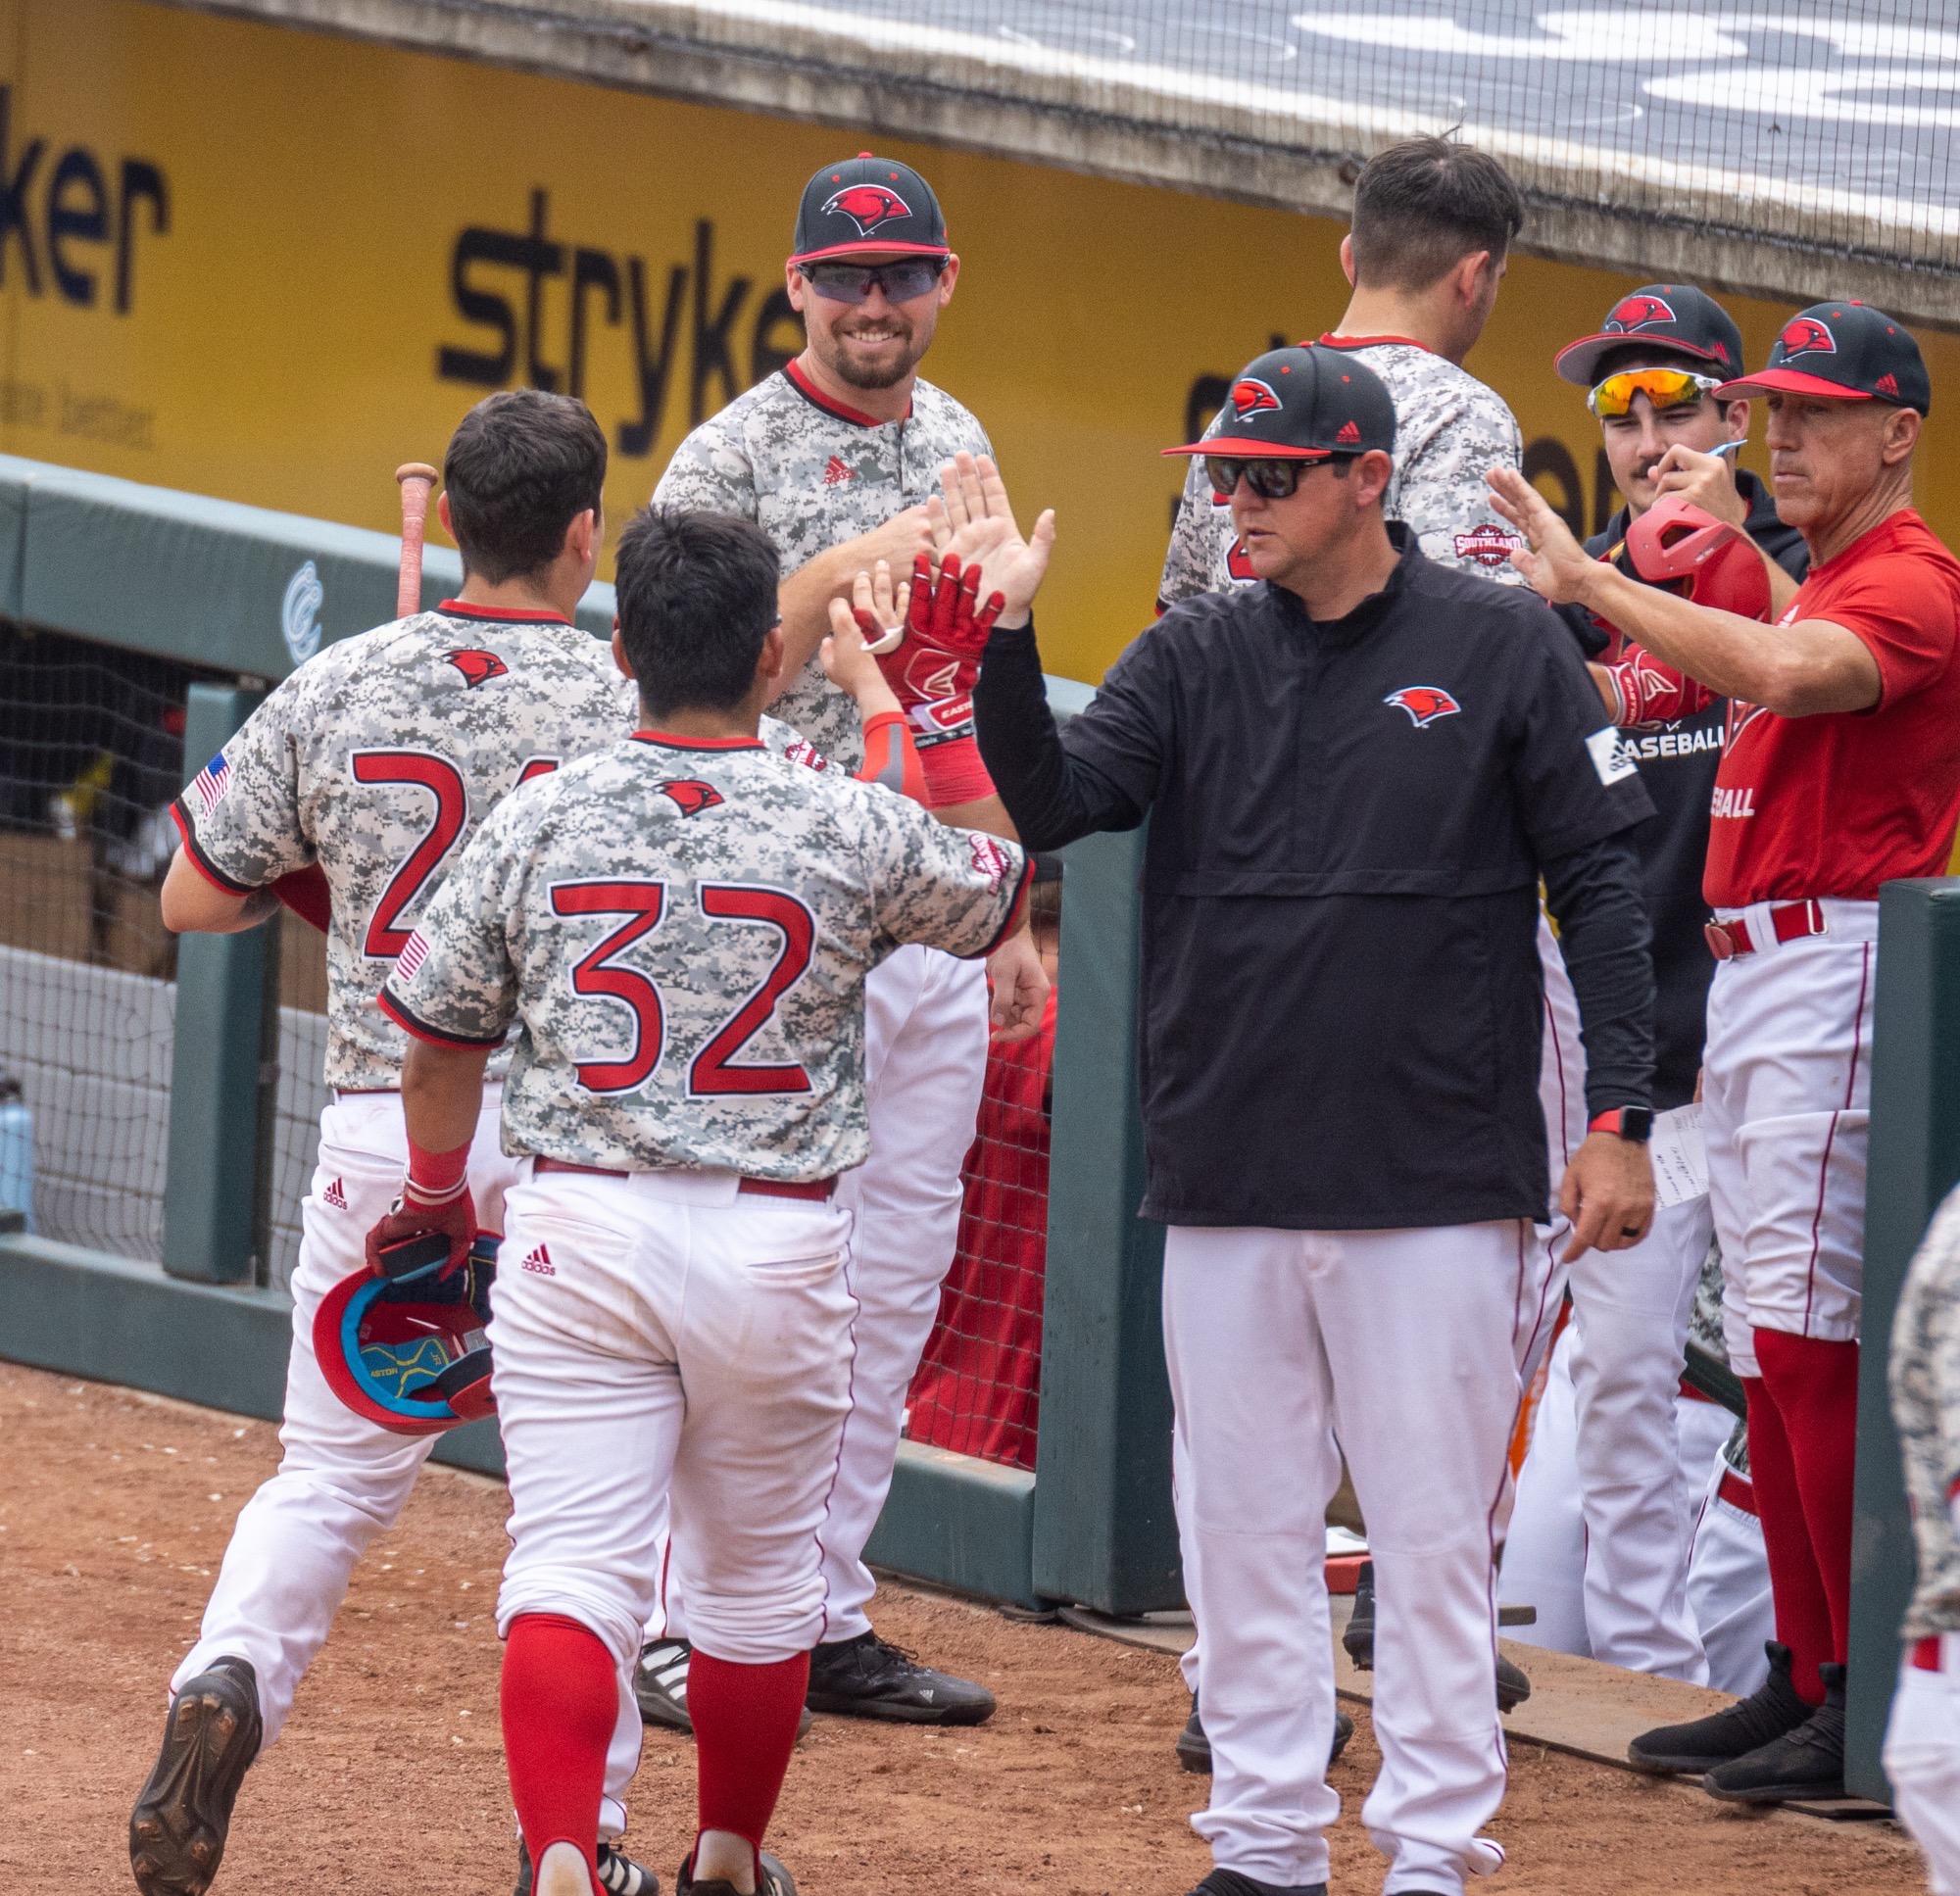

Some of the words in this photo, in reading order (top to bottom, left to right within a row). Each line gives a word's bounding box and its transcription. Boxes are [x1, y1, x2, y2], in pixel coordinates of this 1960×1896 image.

[437, 186, 807, 457] stryke
[1623, 725, 1725, 759] ASEBALL
[349, 747, 563, 960] 2
[547, 876, 817, 1099] 32
[521, 1260, 556, 1276] adidas
